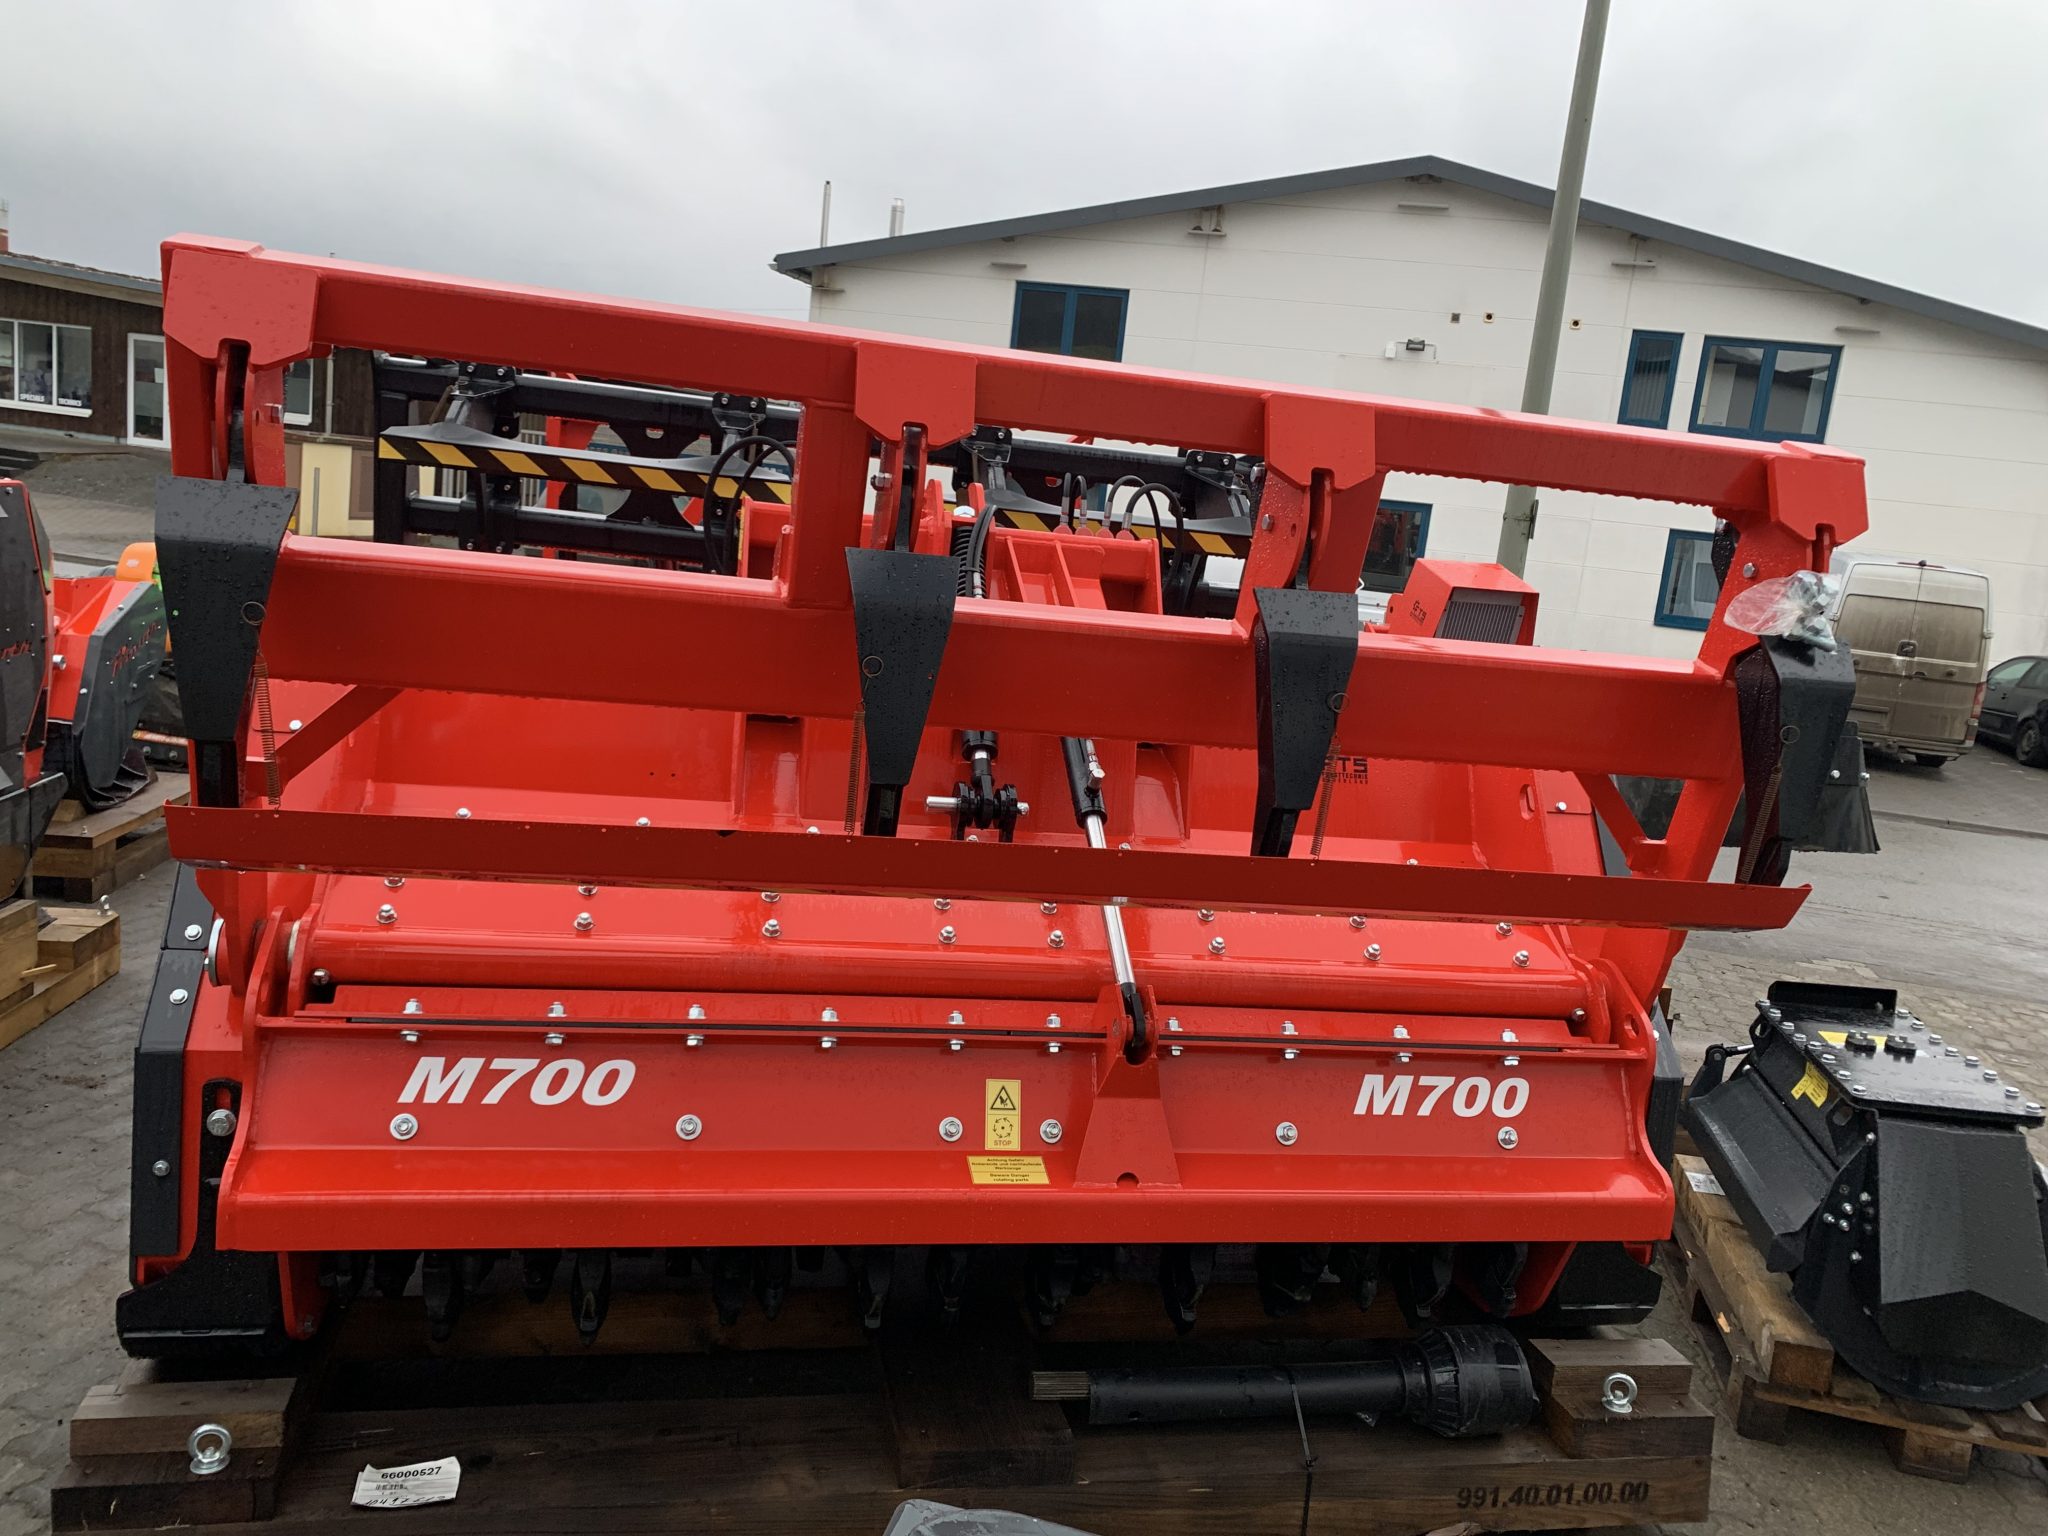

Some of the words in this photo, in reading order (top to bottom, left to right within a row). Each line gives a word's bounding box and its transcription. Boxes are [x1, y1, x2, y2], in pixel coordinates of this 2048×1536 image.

[396, 1056, 636, 1106] M700
[1353, 1074, 1530, 1118] M700
[381, 1466, 442, 1479] 66000527
[1456, 1480, 1649, 1508] 991.40.01.00.00
